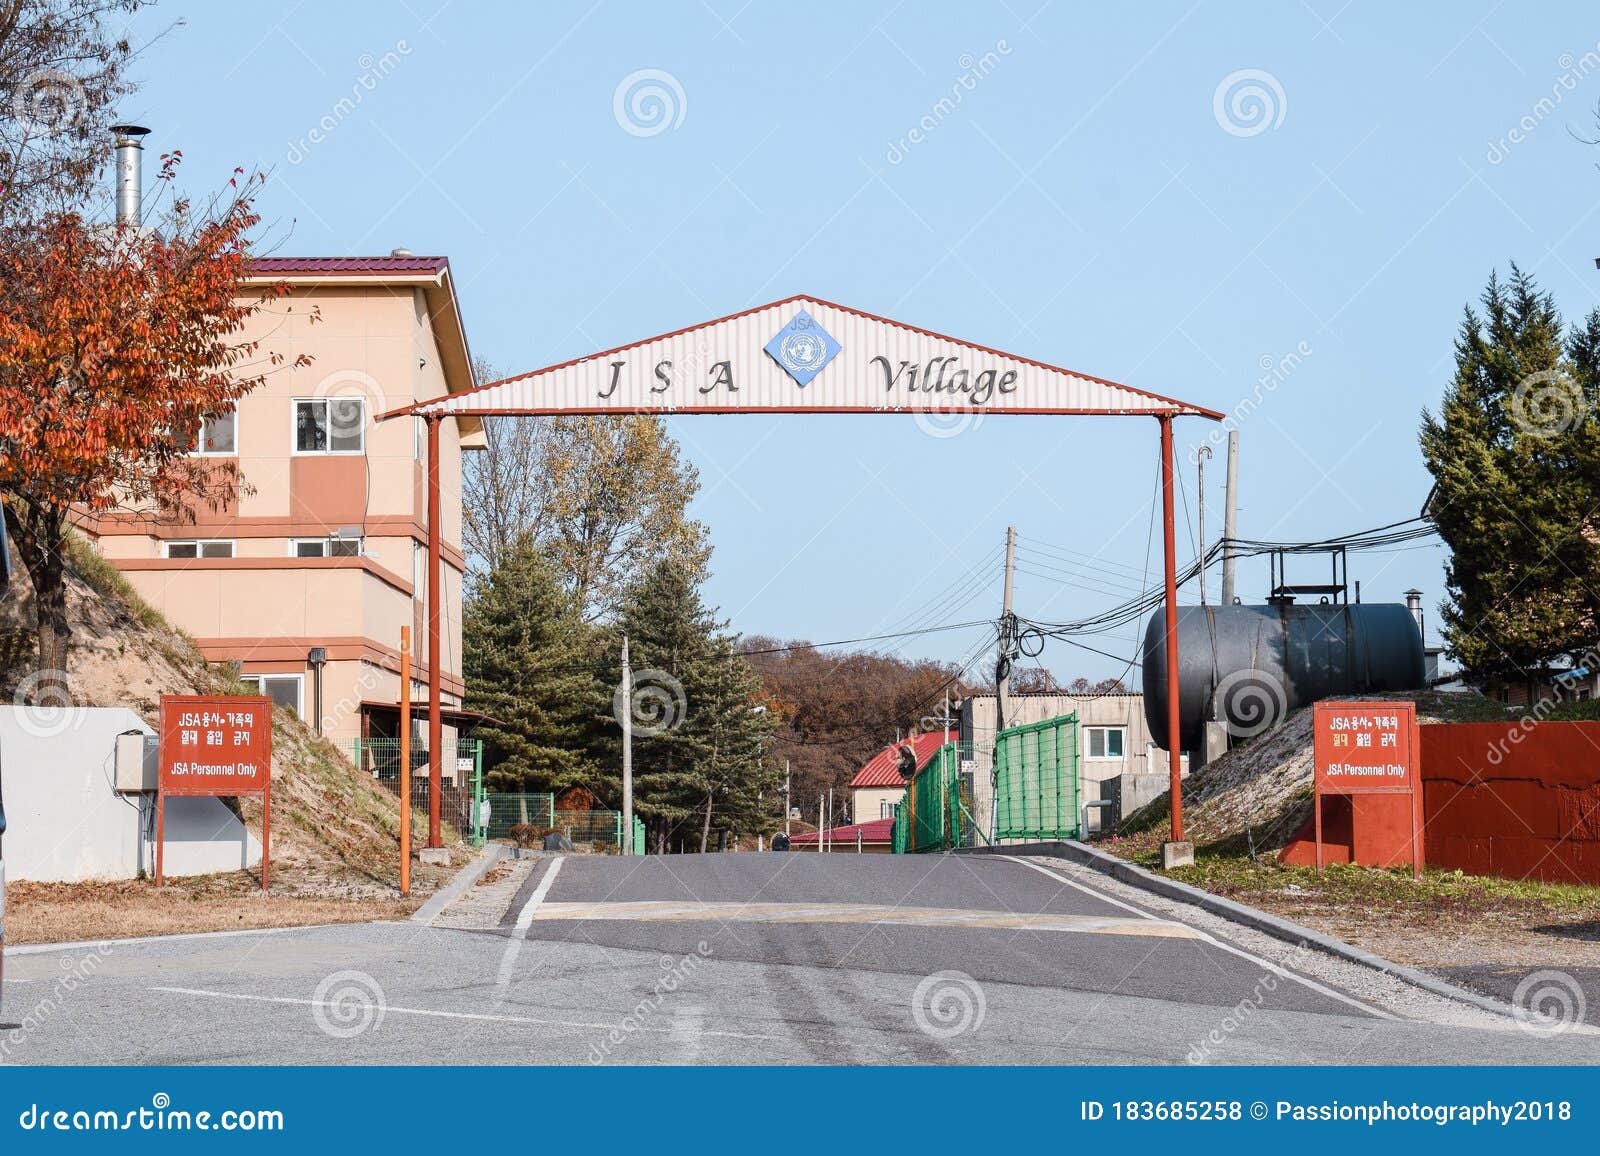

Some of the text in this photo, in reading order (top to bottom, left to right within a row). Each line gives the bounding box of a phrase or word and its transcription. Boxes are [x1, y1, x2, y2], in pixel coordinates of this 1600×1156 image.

[790, 318, 817, 331] JSA
[869, 355, 1018, 405] Village
[233, 731, 250, 746] 금지
[171, 762, 257, 778] JSA Personnel Only
[1326, 764, 1343, 776] JSA
[1387, 764, 1406, 778] Only
